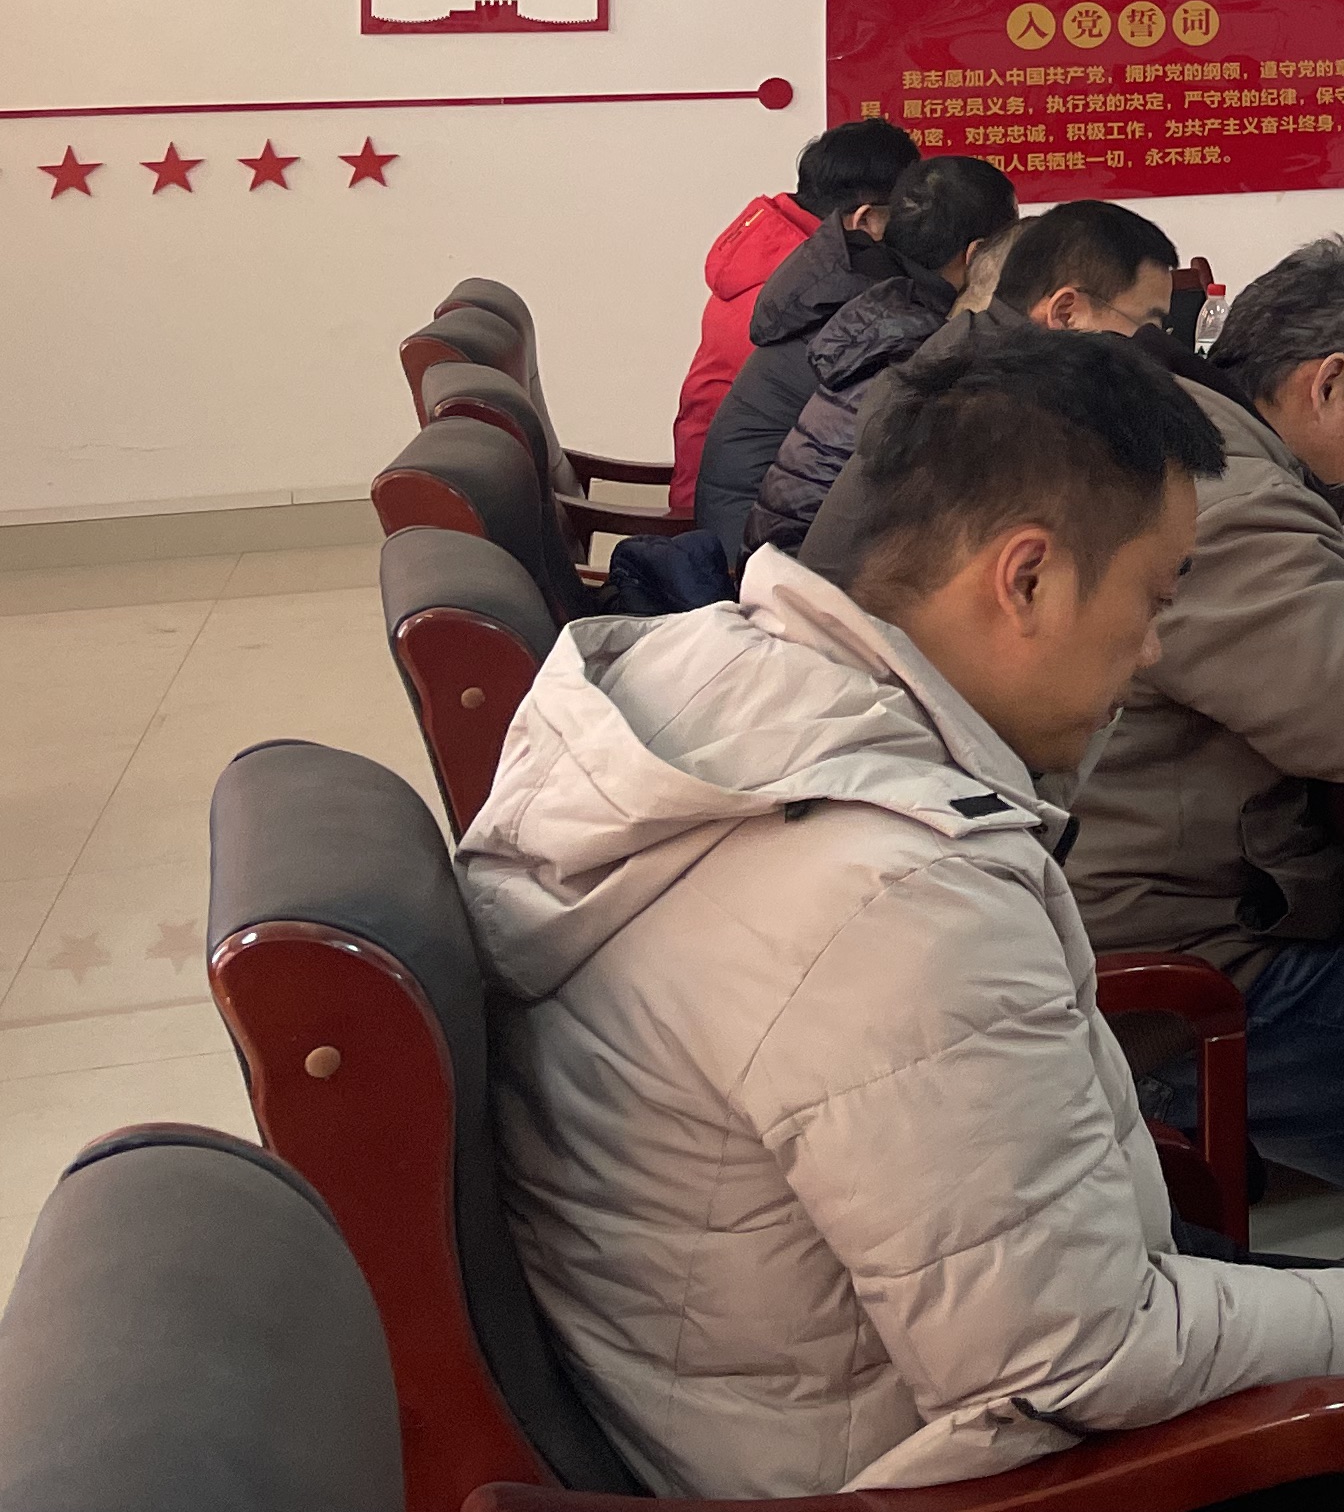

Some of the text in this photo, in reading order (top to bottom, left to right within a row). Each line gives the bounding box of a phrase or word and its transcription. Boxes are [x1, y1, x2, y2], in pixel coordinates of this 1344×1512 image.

[1013, 4, 1213, 42] 入党誓词
[968, 144, 1233, 173] 和人民牺牲一切，永不叛党。
